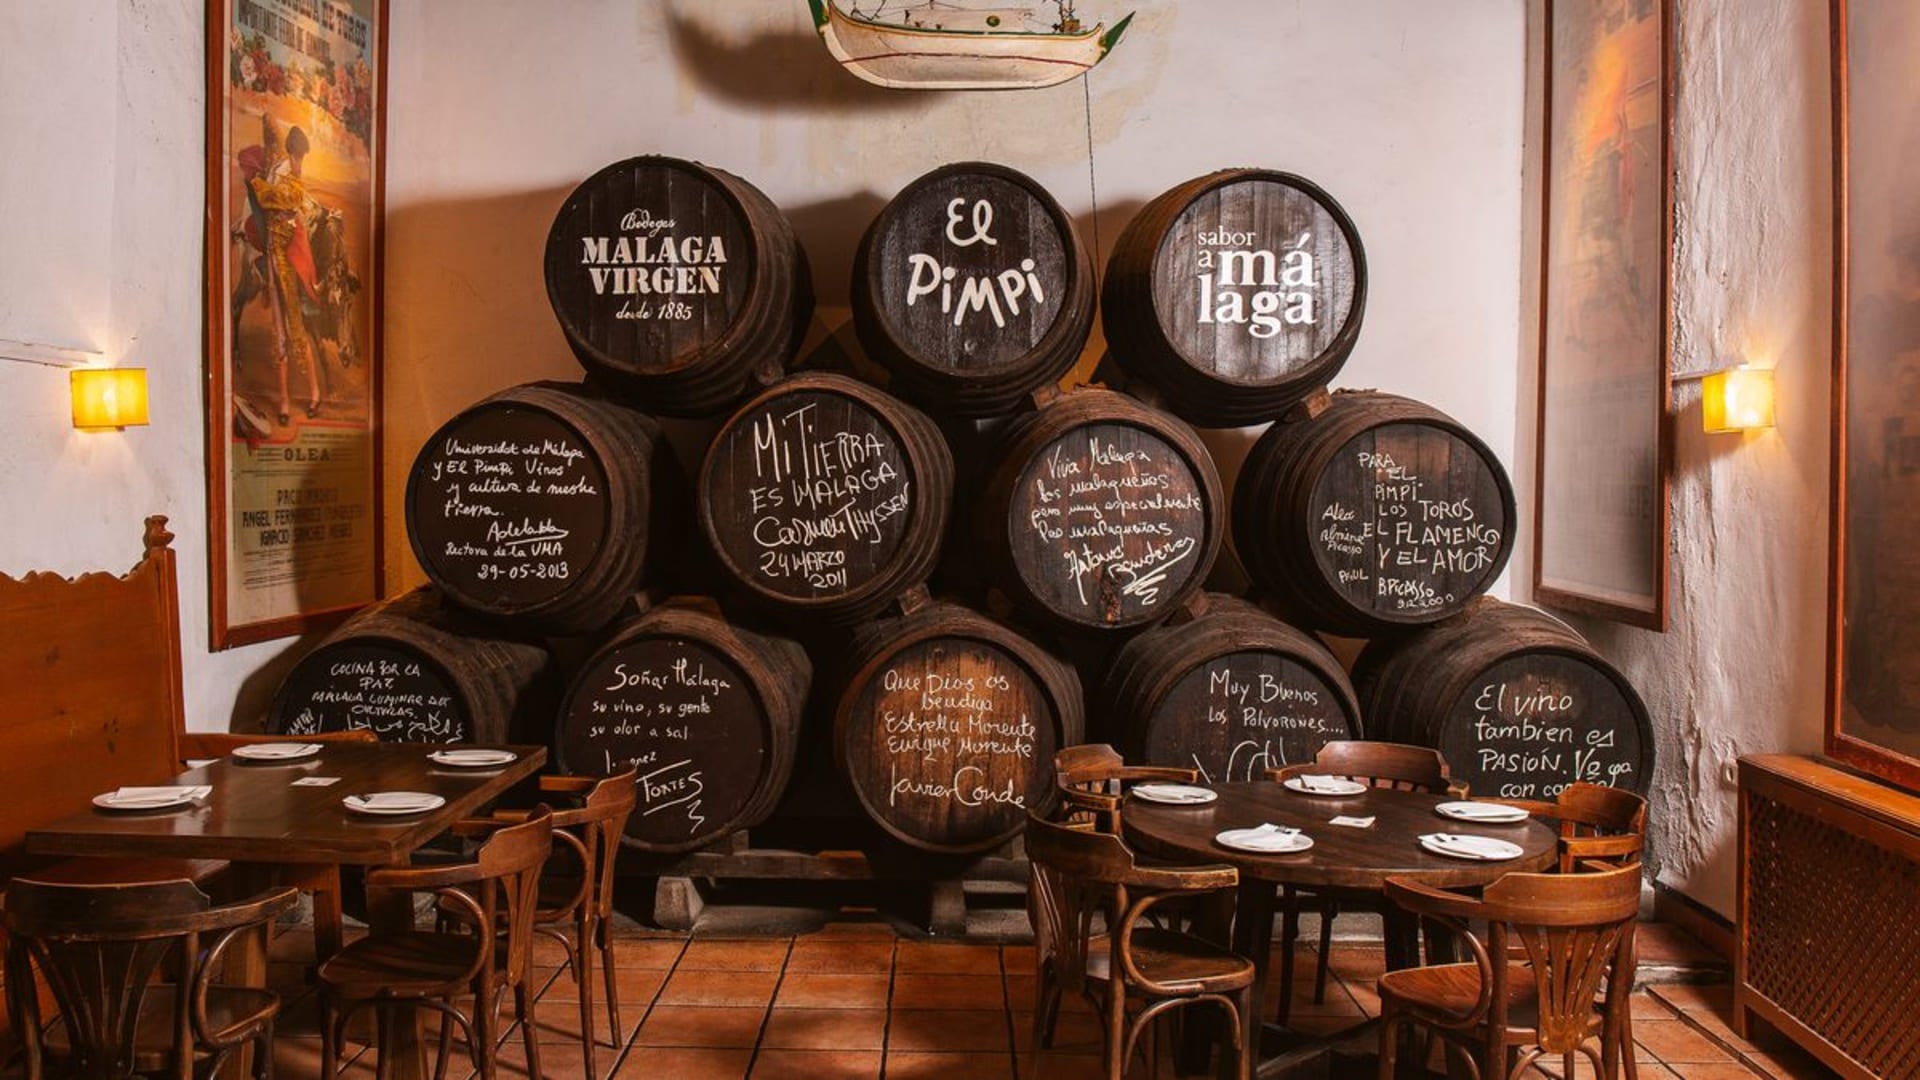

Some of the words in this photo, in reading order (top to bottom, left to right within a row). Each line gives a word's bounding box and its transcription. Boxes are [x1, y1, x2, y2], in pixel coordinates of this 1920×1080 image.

[620, 208, 677, 237] Bodegas
[946, 197, 998, 247] El
[1198, 225, 1256, 246] sabor
[581, 236, 728, 264] MALAGA
[1198, 249, 1215, 268] a
[1217, 232, 1319, 287] má
[588, 266, 723, 295] VIRGEN
[615, 301, 650, 320] desde
[657, 302, 693, 320] 1885
[1197, 273, 1318, 338] laga
[284, 448, 331, 462] OLEA
[522, 444, 541, 455] de
[1048, 445, 1080, 479] Viva
[1357, 452, 1395, 468] PARA
[432, 461, 442, 481] y
[446, 460, 468, 474] El
[525, 458, 564, 476] Vinos
[1386, 466, 1417, 480] EL
[446, 482, 460, 504] y
[468, 476, 521, 493] cultura
[526, 480, 541, 493] de
[750, 487, 784, 514] ES
[792, 461, 898, 510] MALAGA
[1379, 504, 1407, 517] LOS
[1418, 498, 1474, 521] TOROS
[1363, 520, 1389, 538] EL
[1395, 521, 1500, 546] FLAMENCO
[494, 546, 506, 557] de
[509, 545, 527, 557] la
[531, 542, 563, 556] UMA
[1378, 544, 1391, 569] Y
[1396, 547, 1428, 565] EL
[1431, 546, 1493, 575] AMOR
[760, 551, 789, 577] 24
[792, 550, 845, 578] MARZO
[809, 568, 847, 588] 2011
[606, 663, 669, 691] Soñar
[884, 669, 921, 692] Que
[926, 673, 975, 695] Dios
[985, 675, 1010, 691] os
[1210, 668, 1250, 705] Muy
[1258, 674, 1318, 706] Buenos
[592, 701, 607, 713] su
[658, 702, 673, 713] su
[678, 695, 711, 717] gente
[921, 692, 993, 714] bendiga
[1474, 683, 1506, 712] El
[1514, 688, 1573, 717] vino
[589, 726, 605, 737] su
[614, 719, 641, 735] olor
[649, 727, 658, 737] a
[666, 725, 688, 740] sal
[885, 711, 960, 735] Estrella
[968, 713, 1037, 741] Morente
[1474, 714, 1573, 743] tambien
[956, 736, 1033, 759] Morente
[889, 762, 957, 808] Javier
[954, 766, 1026, 809] Conde
[1500, 783, 1535, 798] con
